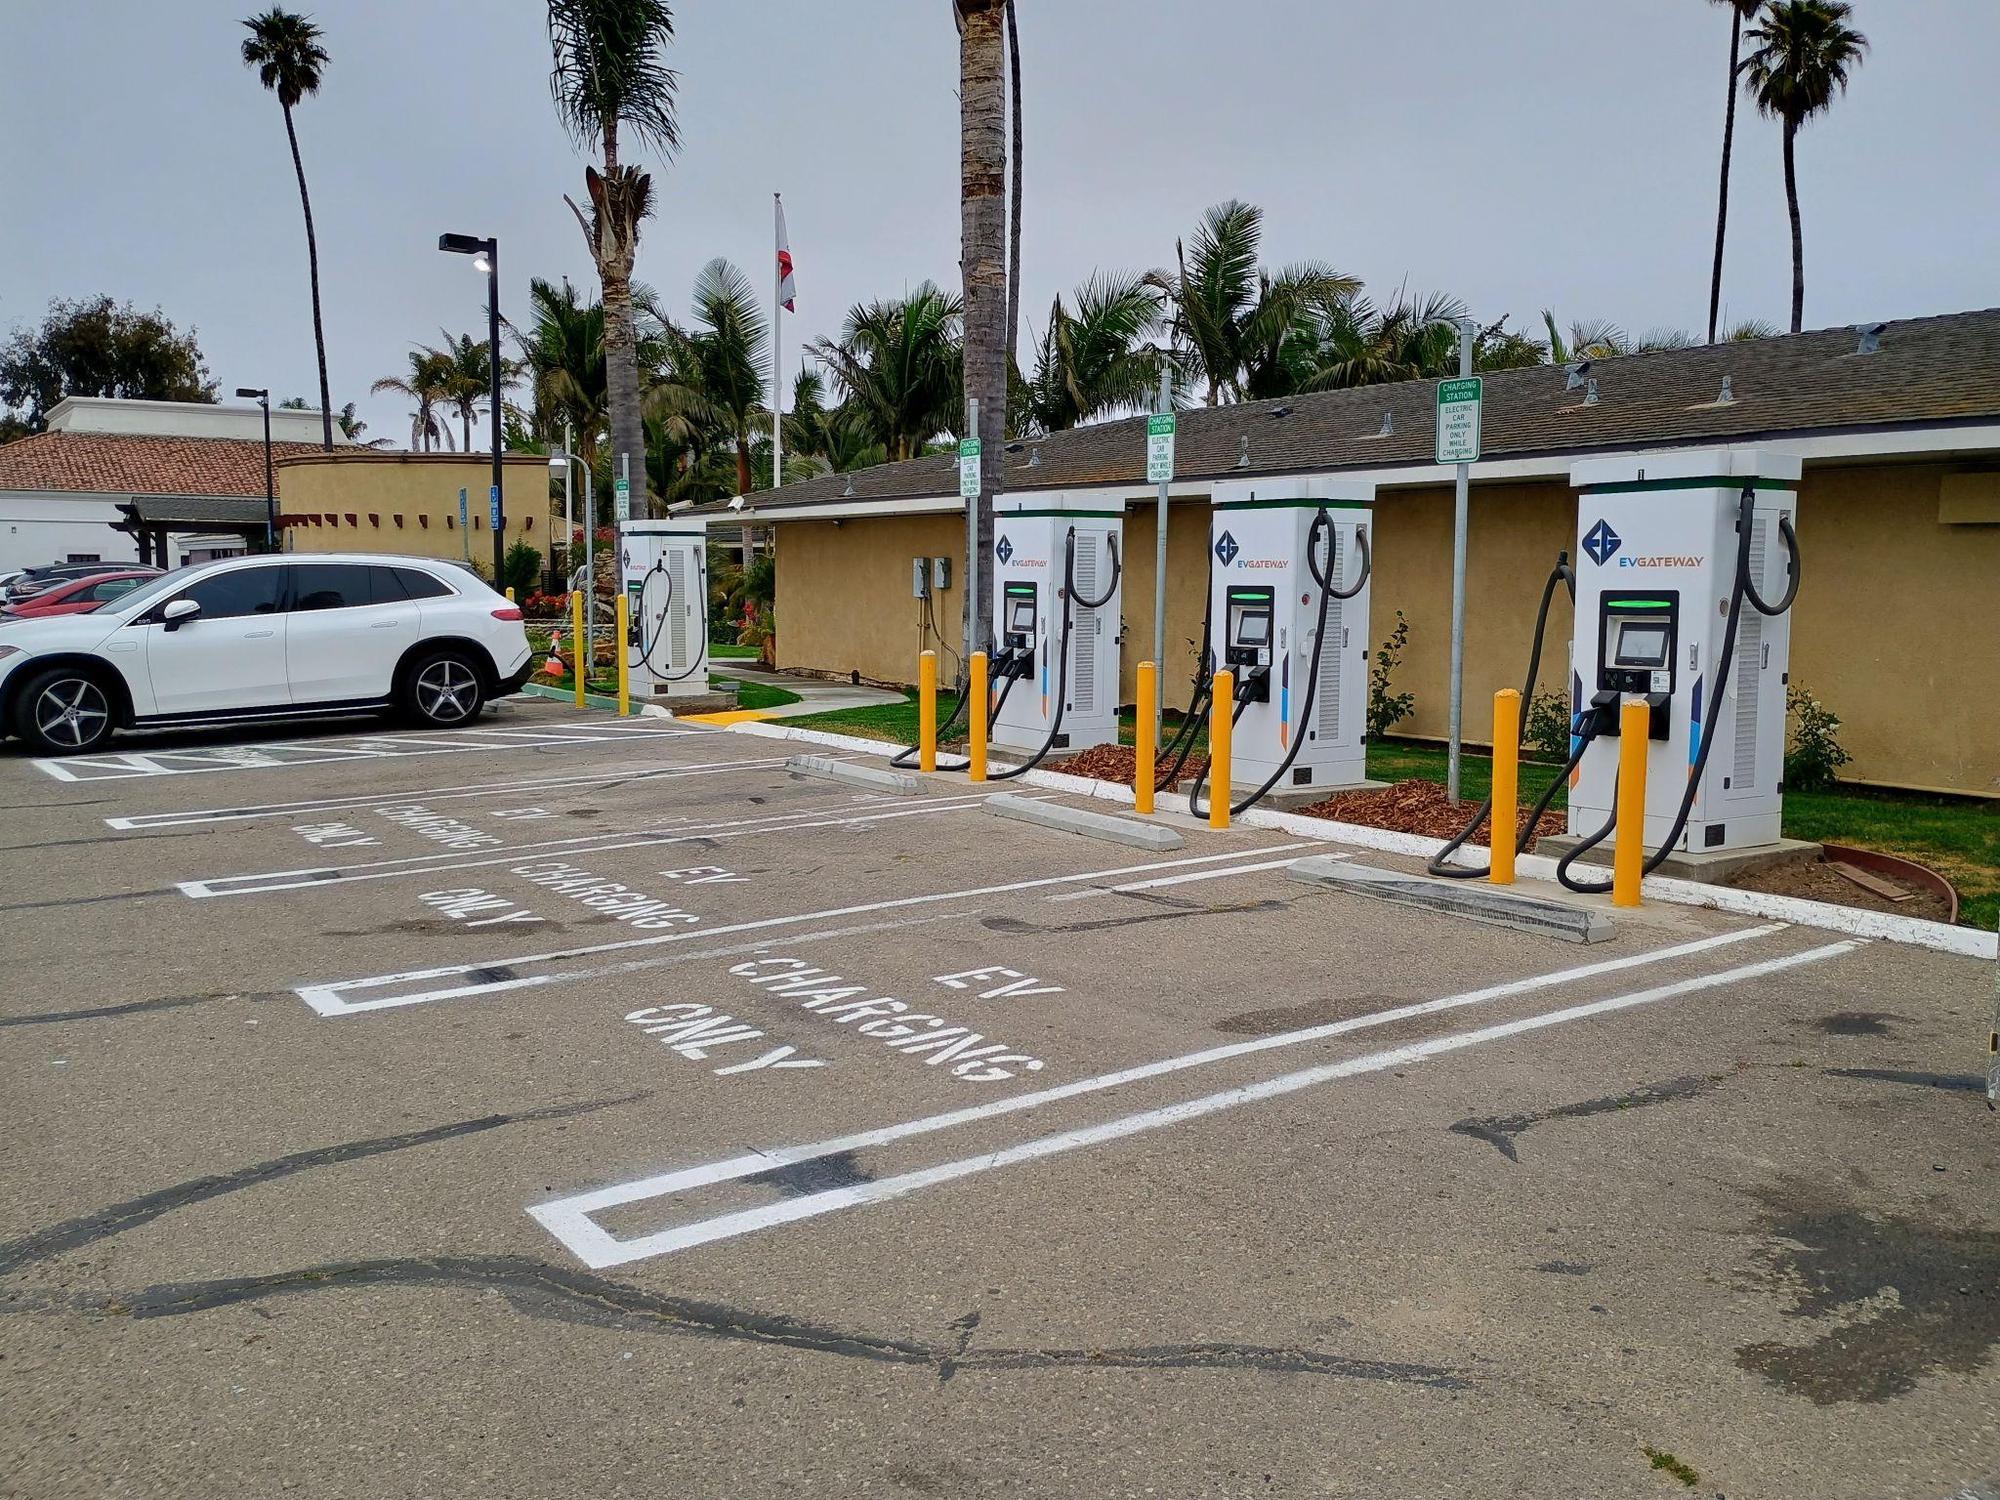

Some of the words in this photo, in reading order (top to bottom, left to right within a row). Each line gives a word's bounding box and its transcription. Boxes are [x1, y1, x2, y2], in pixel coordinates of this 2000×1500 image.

[1442, 381, 1477, 392] CHARGING
[1446, 391, 1474, 401] STATION
[1445, 405, 1473, 414] ELECTRIC
[1151, 424, 1171, 434] STATION
[1445, 422, 1471, 430] PARKING
[1449, 431, 1466, 439] ONLY
[1442, 448, 1473, 456] CHARGING
[1237, 560, 1289, 568] EVGATEWAY
[1619, 557, 1704, 567] EVGATEWAY
[373, 805, 504, 849] CHARGING
[291, 822, 383, 848] ONLY
[658, 865, 752, 885] EV
[510, 862, 700, 929] CHARGING
[417, 888, 546, 927] ONLY
[932, 965, 1067, 999] EV
[729, 957, 1044, 1082] CHARGING
[624, 1003, 825, 1076] ONLY
